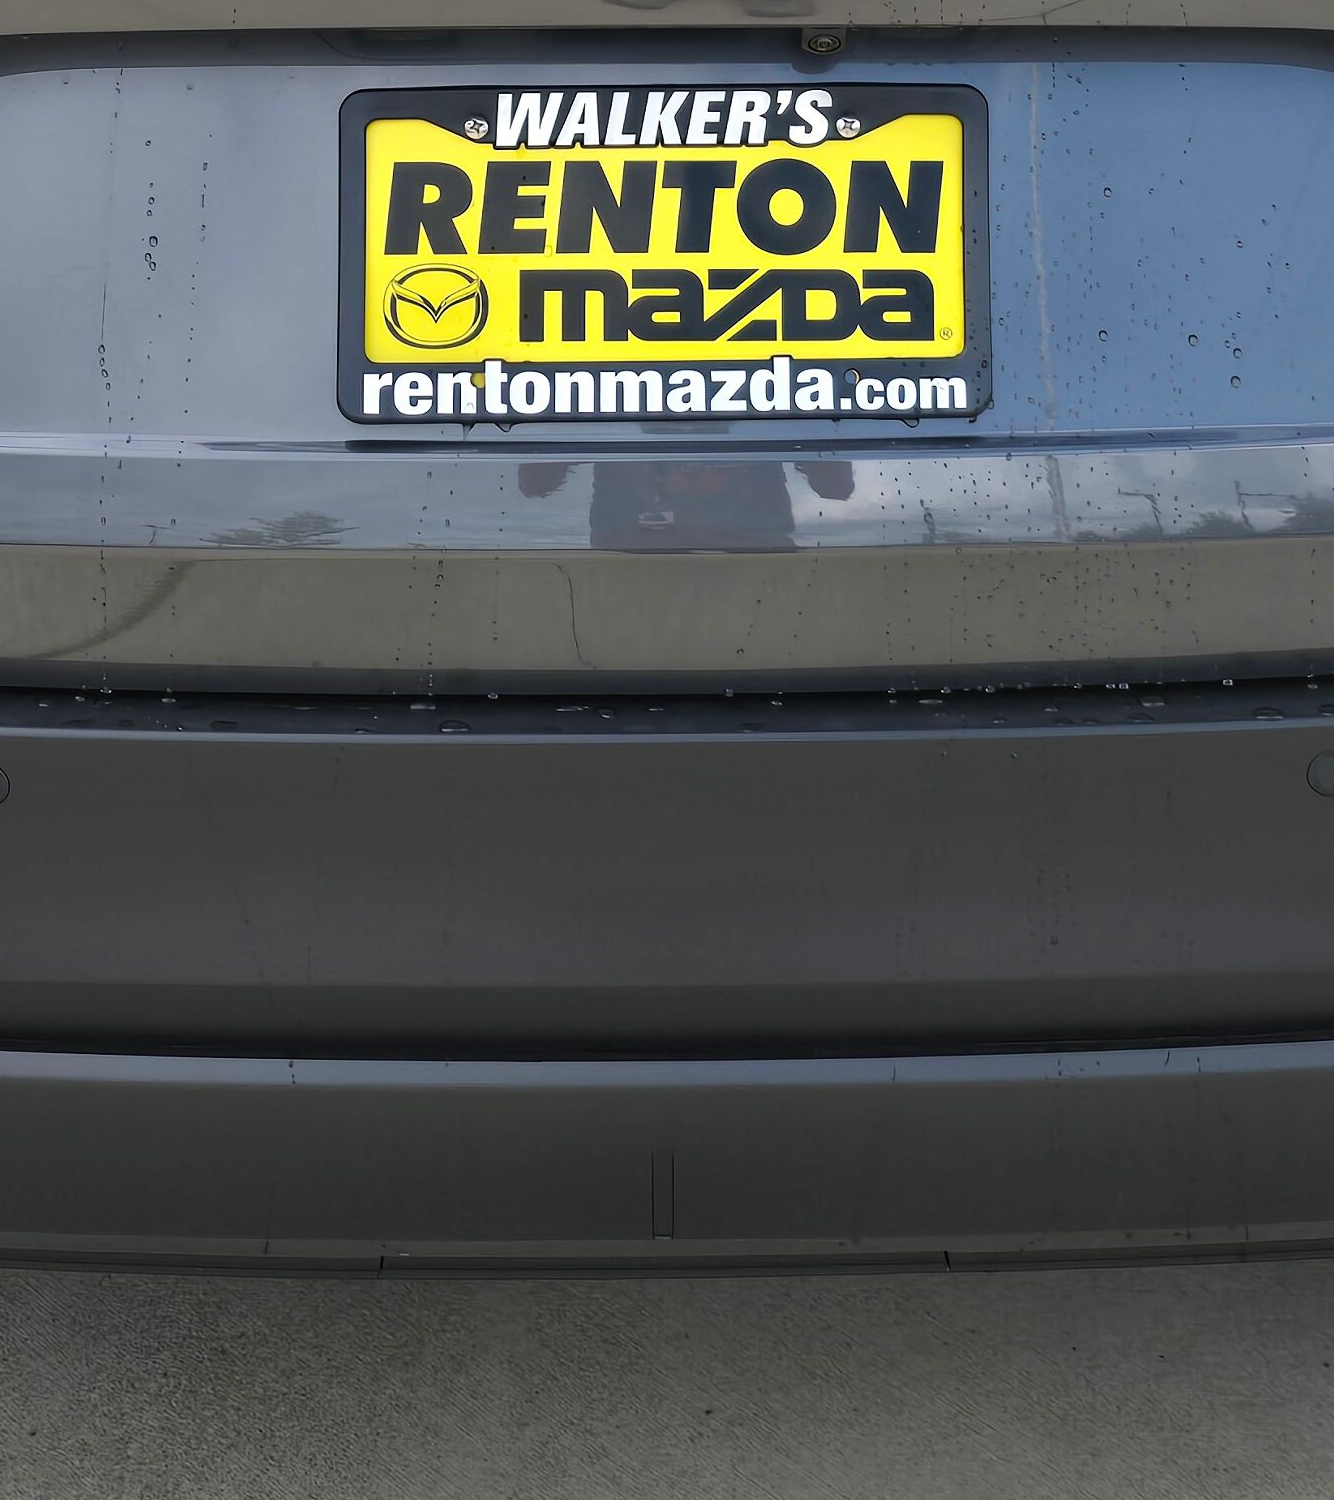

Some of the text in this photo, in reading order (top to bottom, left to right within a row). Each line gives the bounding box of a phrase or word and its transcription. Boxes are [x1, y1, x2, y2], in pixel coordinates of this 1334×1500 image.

[494, 89, 834, 149] WALKER'S
[383, 158, 944, 256] RENTON
[362, 355, 968, 415] rentonmazda.com
